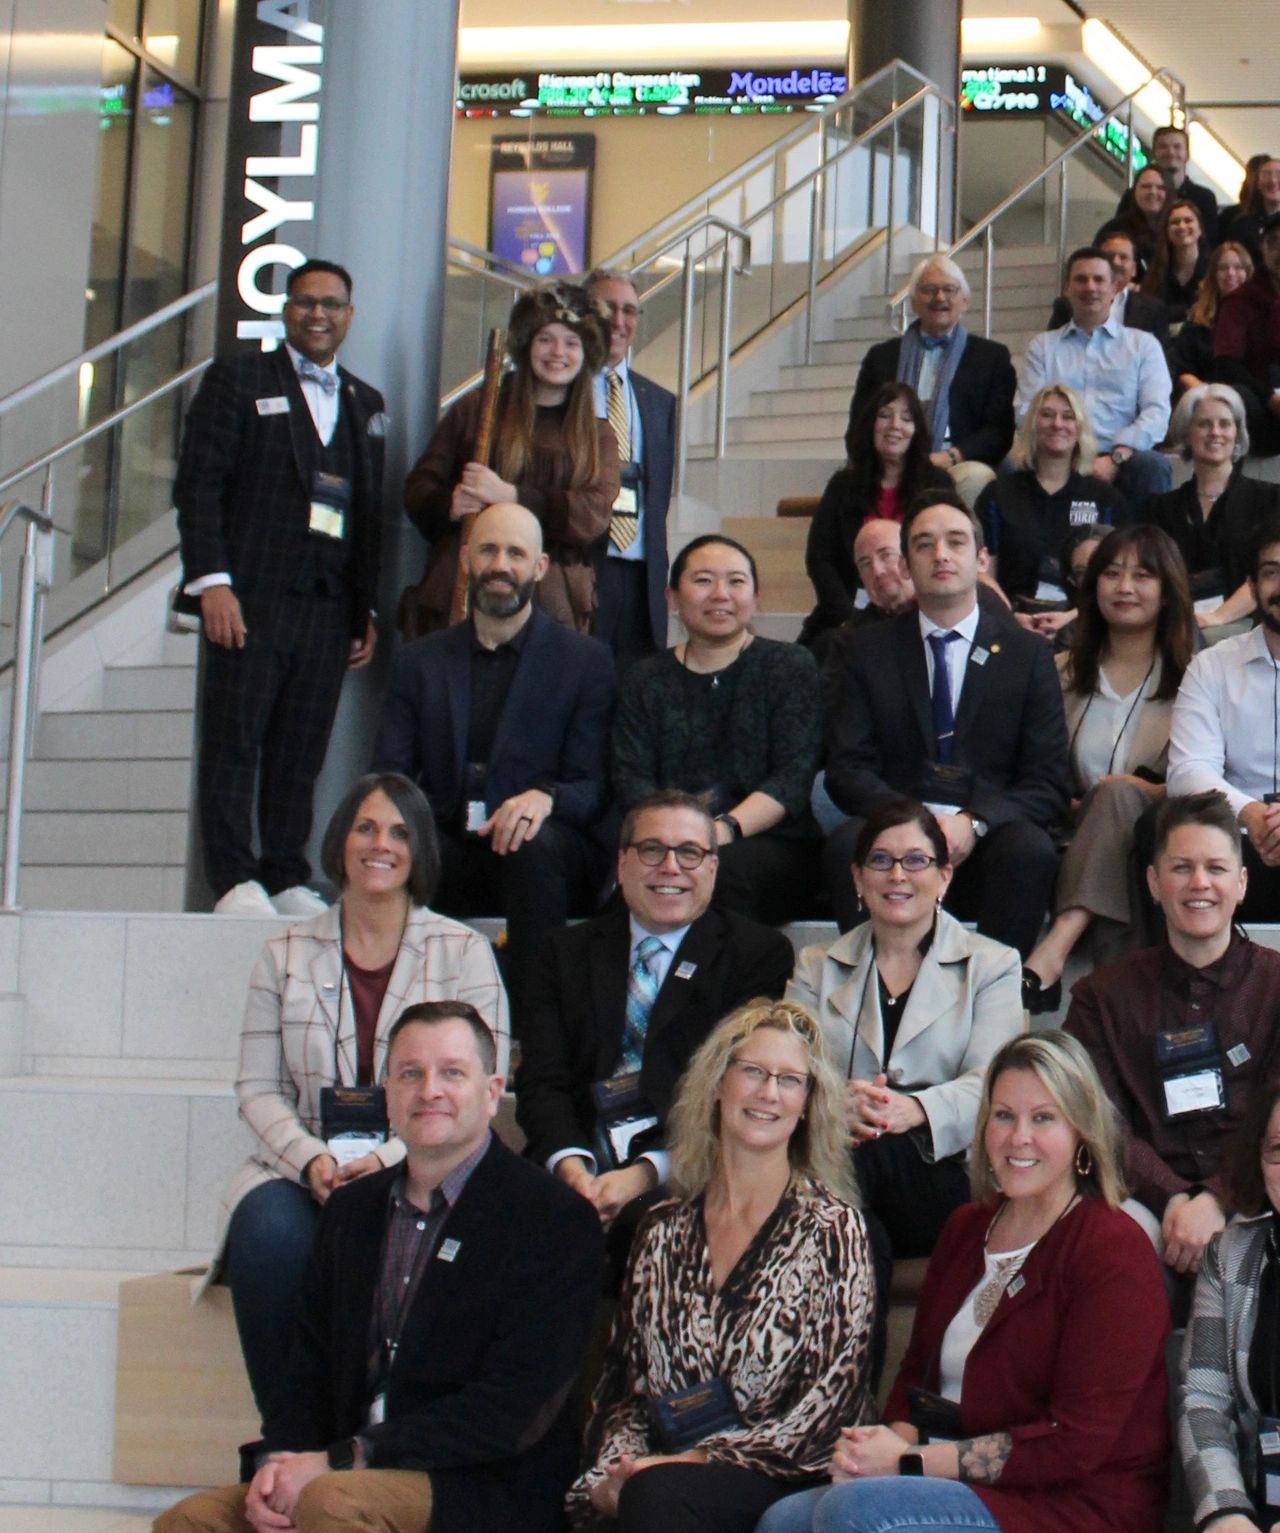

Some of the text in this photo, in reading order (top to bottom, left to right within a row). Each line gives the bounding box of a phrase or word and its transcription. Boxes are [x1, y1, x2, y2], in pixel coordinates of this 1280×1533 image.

[456, 78, 526, 99] icrosoft
[727, 69, 847, 98] Mondelēz
[236, 0, 324, 353] OYLMA
